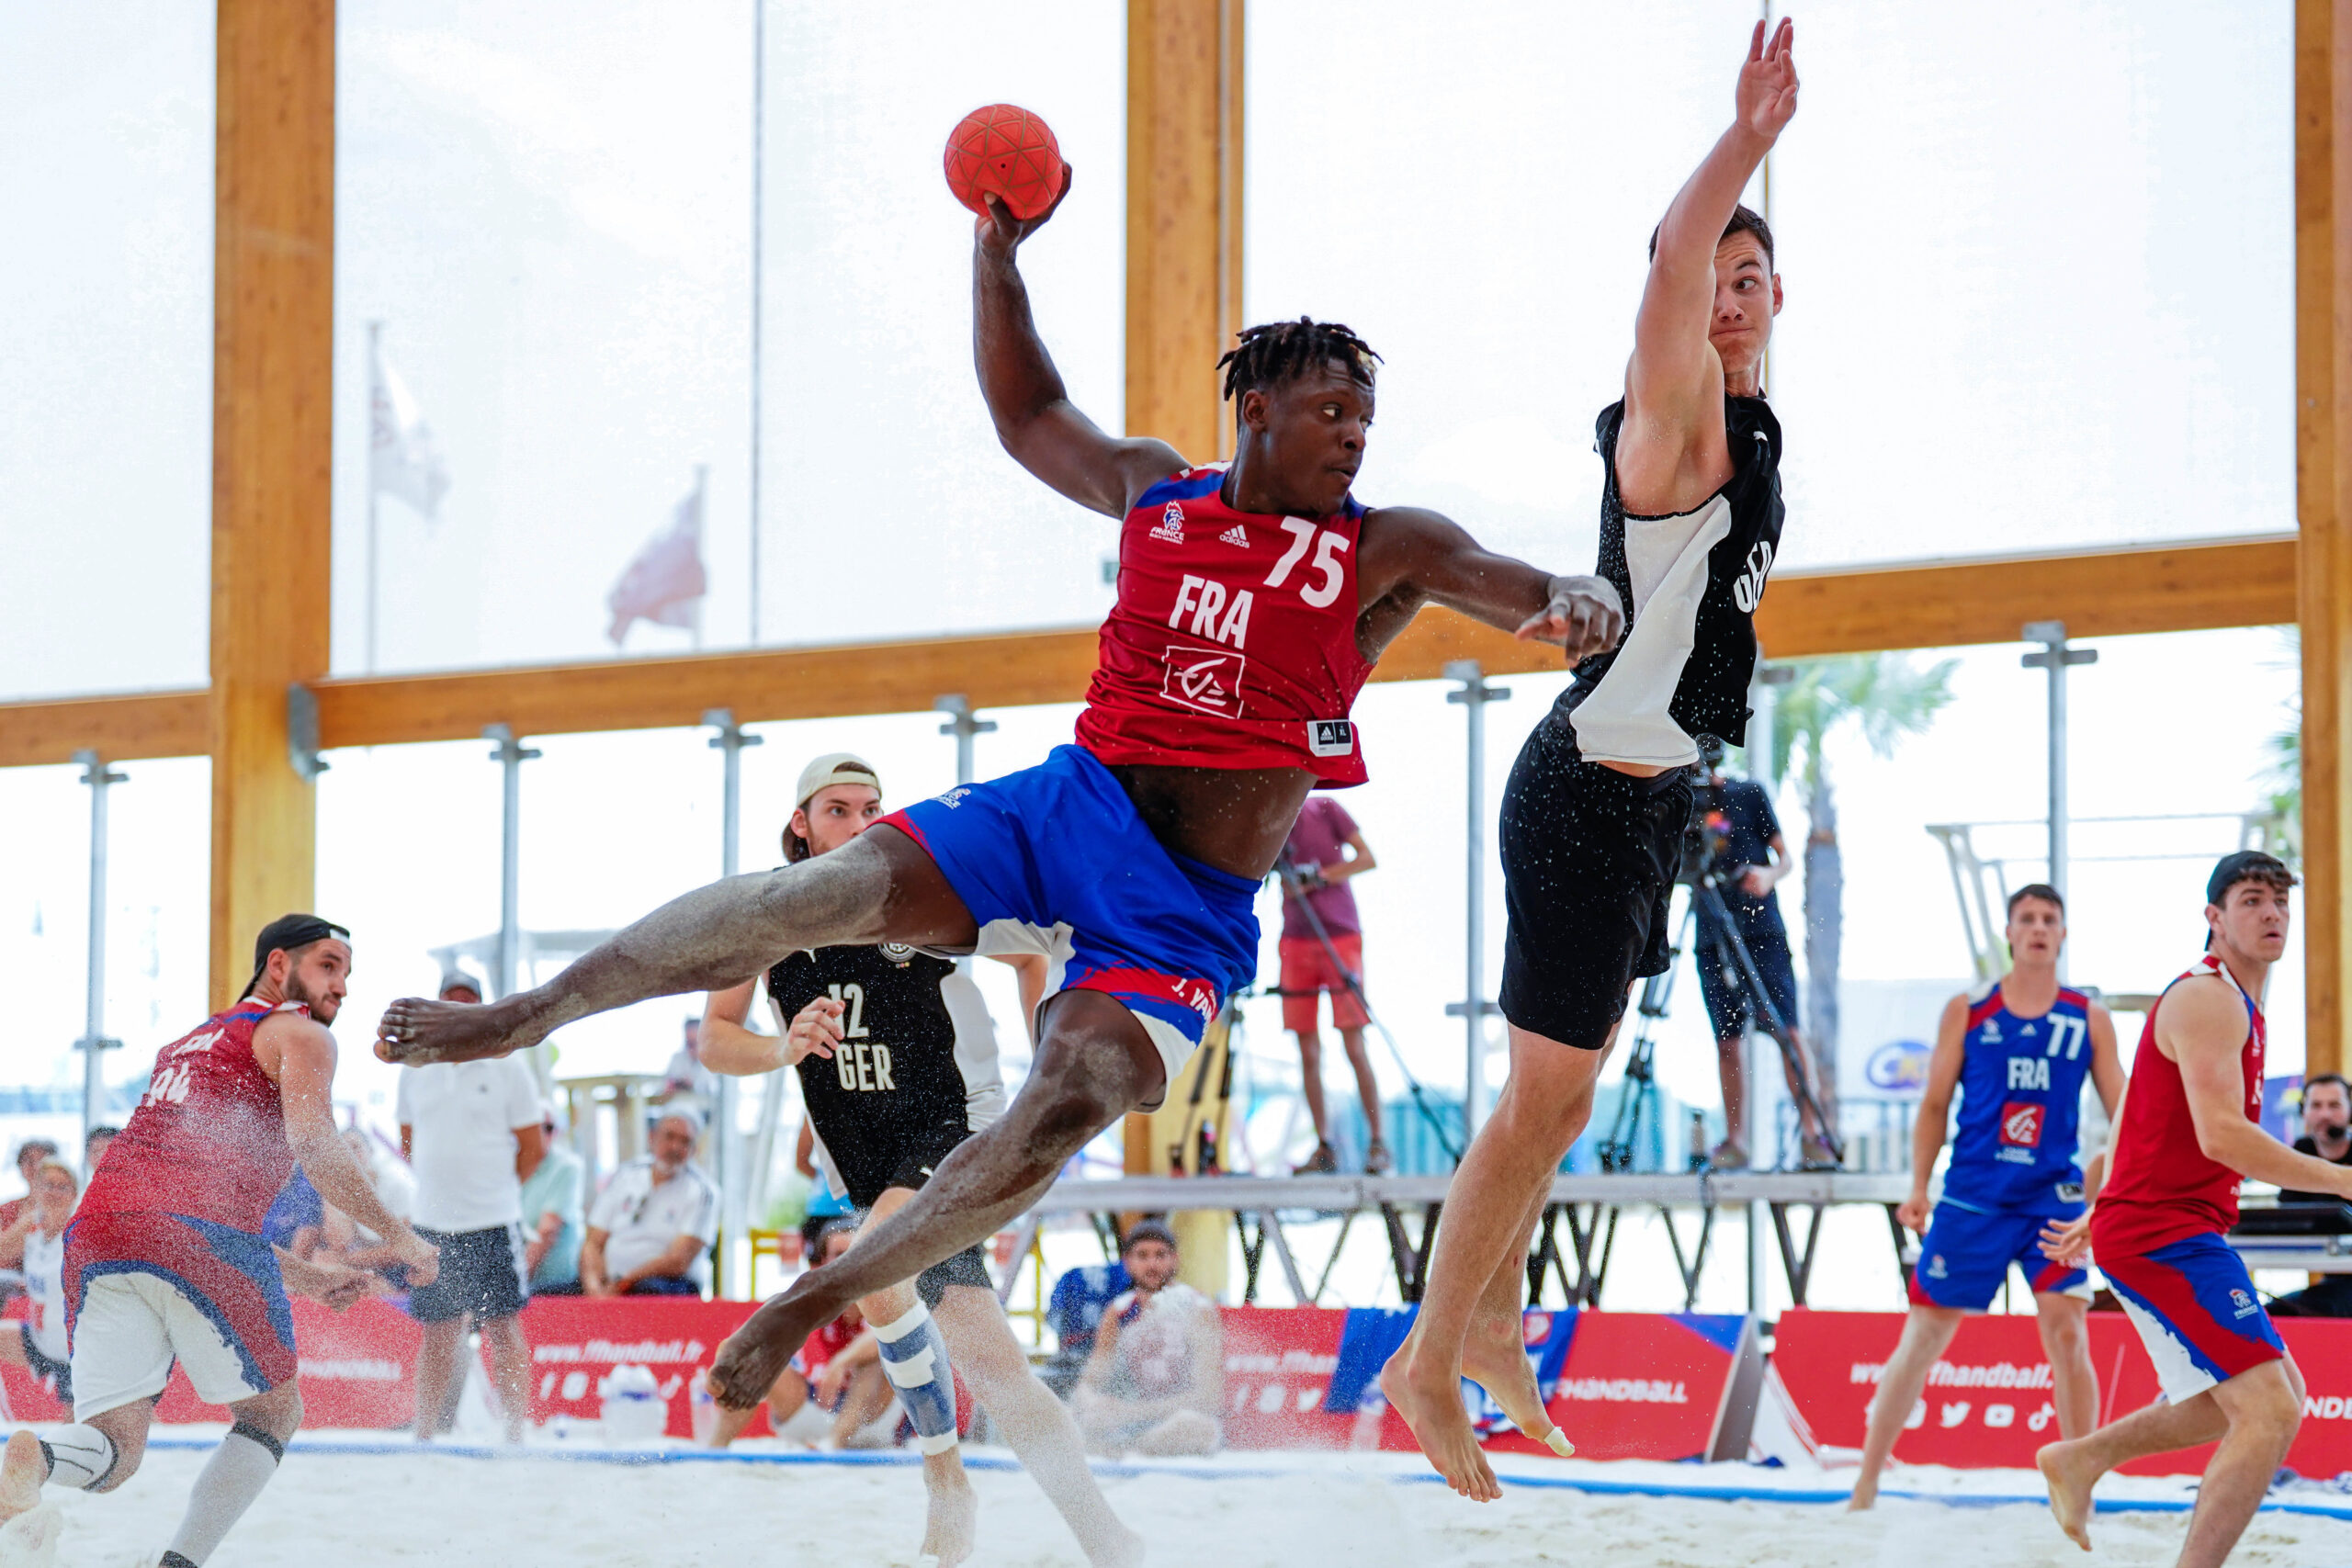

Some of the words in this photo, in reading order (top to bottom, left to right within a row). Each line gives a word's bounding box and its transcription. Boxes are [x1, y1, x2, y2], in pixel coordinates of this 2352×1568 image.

[1219, 535, 1250, 548] adidas
[1263, 515, 1350, 608] 75
[1169, 574, 1253, 649] FRA
[828, 983, 870, 1038] 12
[2046, 1012, 2086, 1060] 77
[835, 1043, 897, 1092] GER
[2007, 1056, 2051, 1091] FRA
